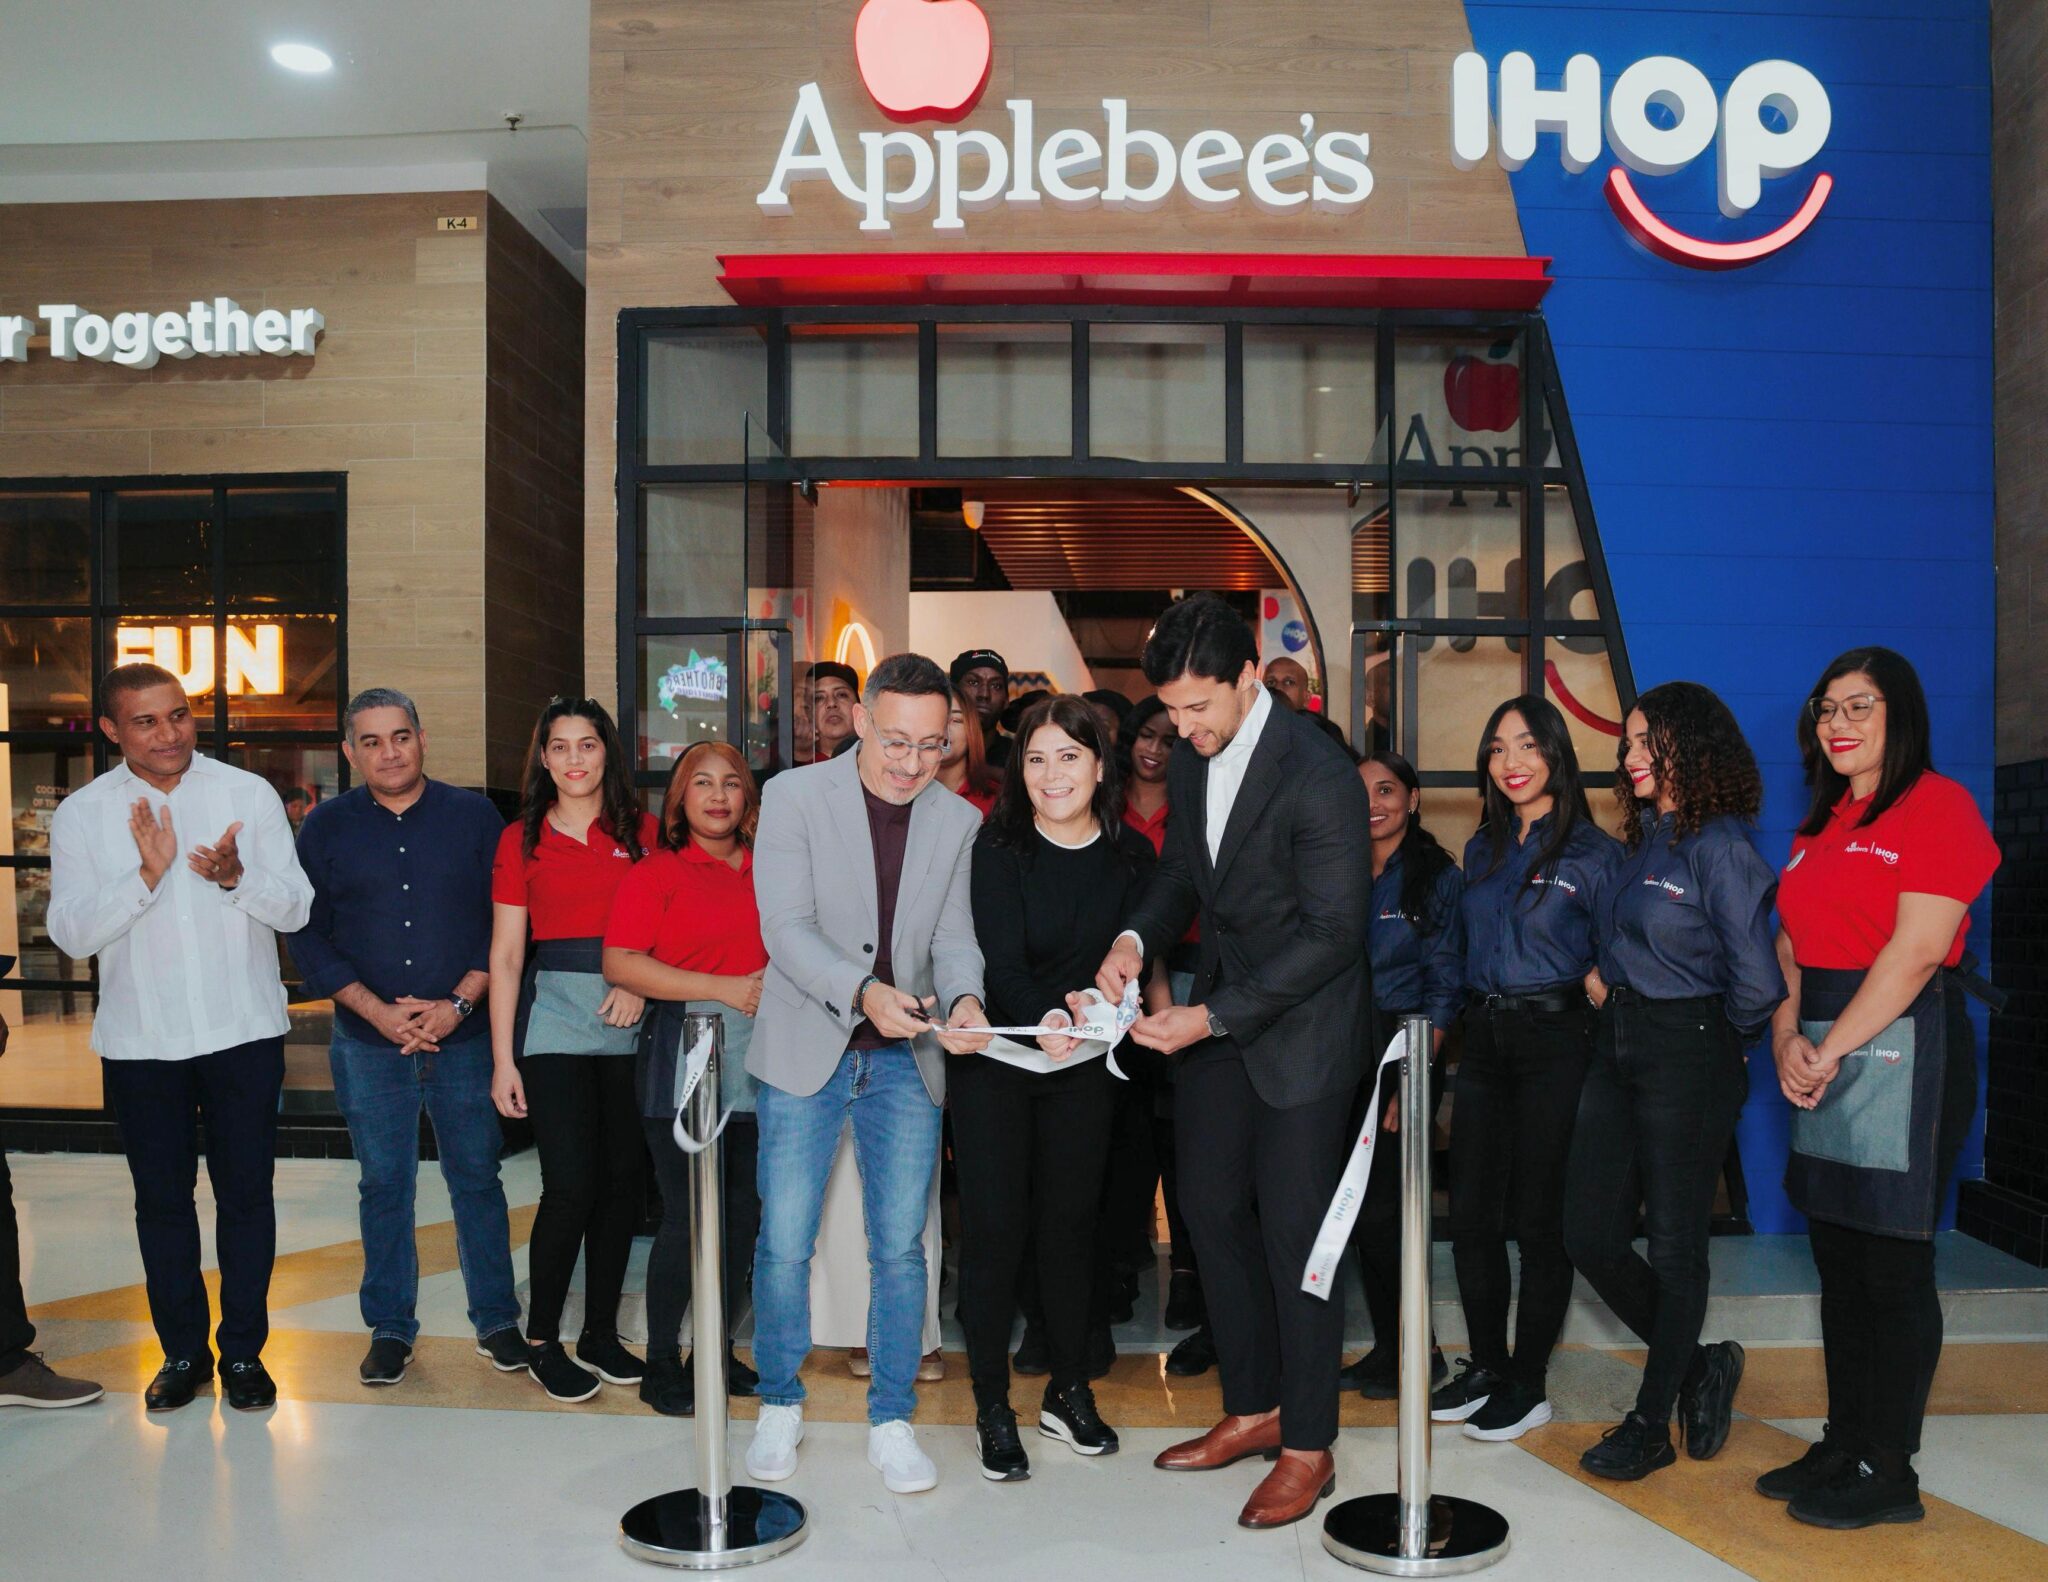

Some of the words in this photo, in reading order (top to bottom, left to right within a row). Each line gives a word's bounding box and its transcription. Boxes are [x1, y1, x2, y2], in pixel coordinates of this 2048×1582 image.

[756, 82, 1374, 236] Applebee's
[1451, 51, 1832, 217] IHOP
[447, 217, 467, 229] K-4
[39, 297, 324, 369] Together
[117, 624, 284, 697] FUN
